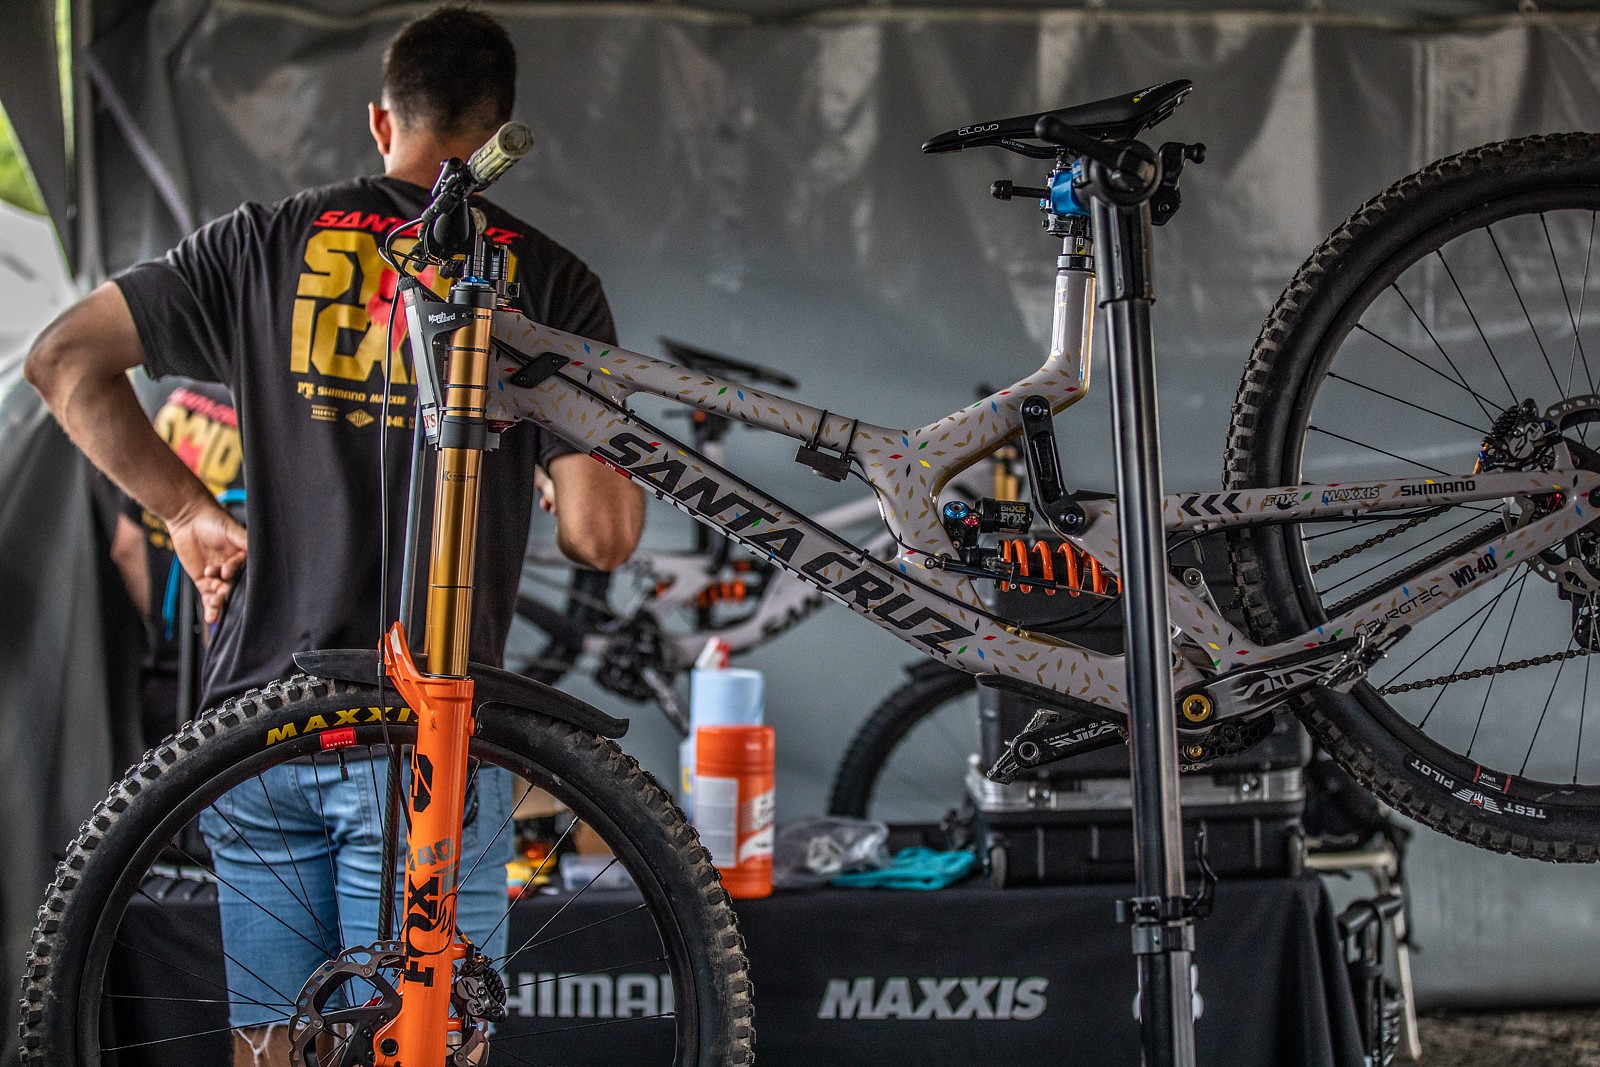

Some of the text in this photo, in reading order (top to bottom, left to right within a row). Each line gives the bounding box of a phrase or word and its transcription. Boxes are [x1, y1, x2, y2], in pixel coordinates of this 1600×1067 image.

[958, 124, 999, 136] CLOUD
[317, 385, 367, 402] SHIMANO
[369, 394, 407, 405] MAXIS
[1322, 487, 1380, 501] MAXXIS
[1400, 480, 1476, 497] SHIMANO
[1264, 493, 1300, 511] FOX
[1000, 512, 1026, 529] FOX
[592, 432, 976, 655] SANTA CRUZ
[1449, 553, 1498, 589] WD-40
[266, 706, 419, 746] MAXXI
[1410, 759, 1455, 790] PILOT
[1503, 802, 1547, 819] TEST
[403, 873, 457, 988] FOX
[503, 971, 676, 1019] HIMA
[816, 976, 1049, 1020] MAXXIS
